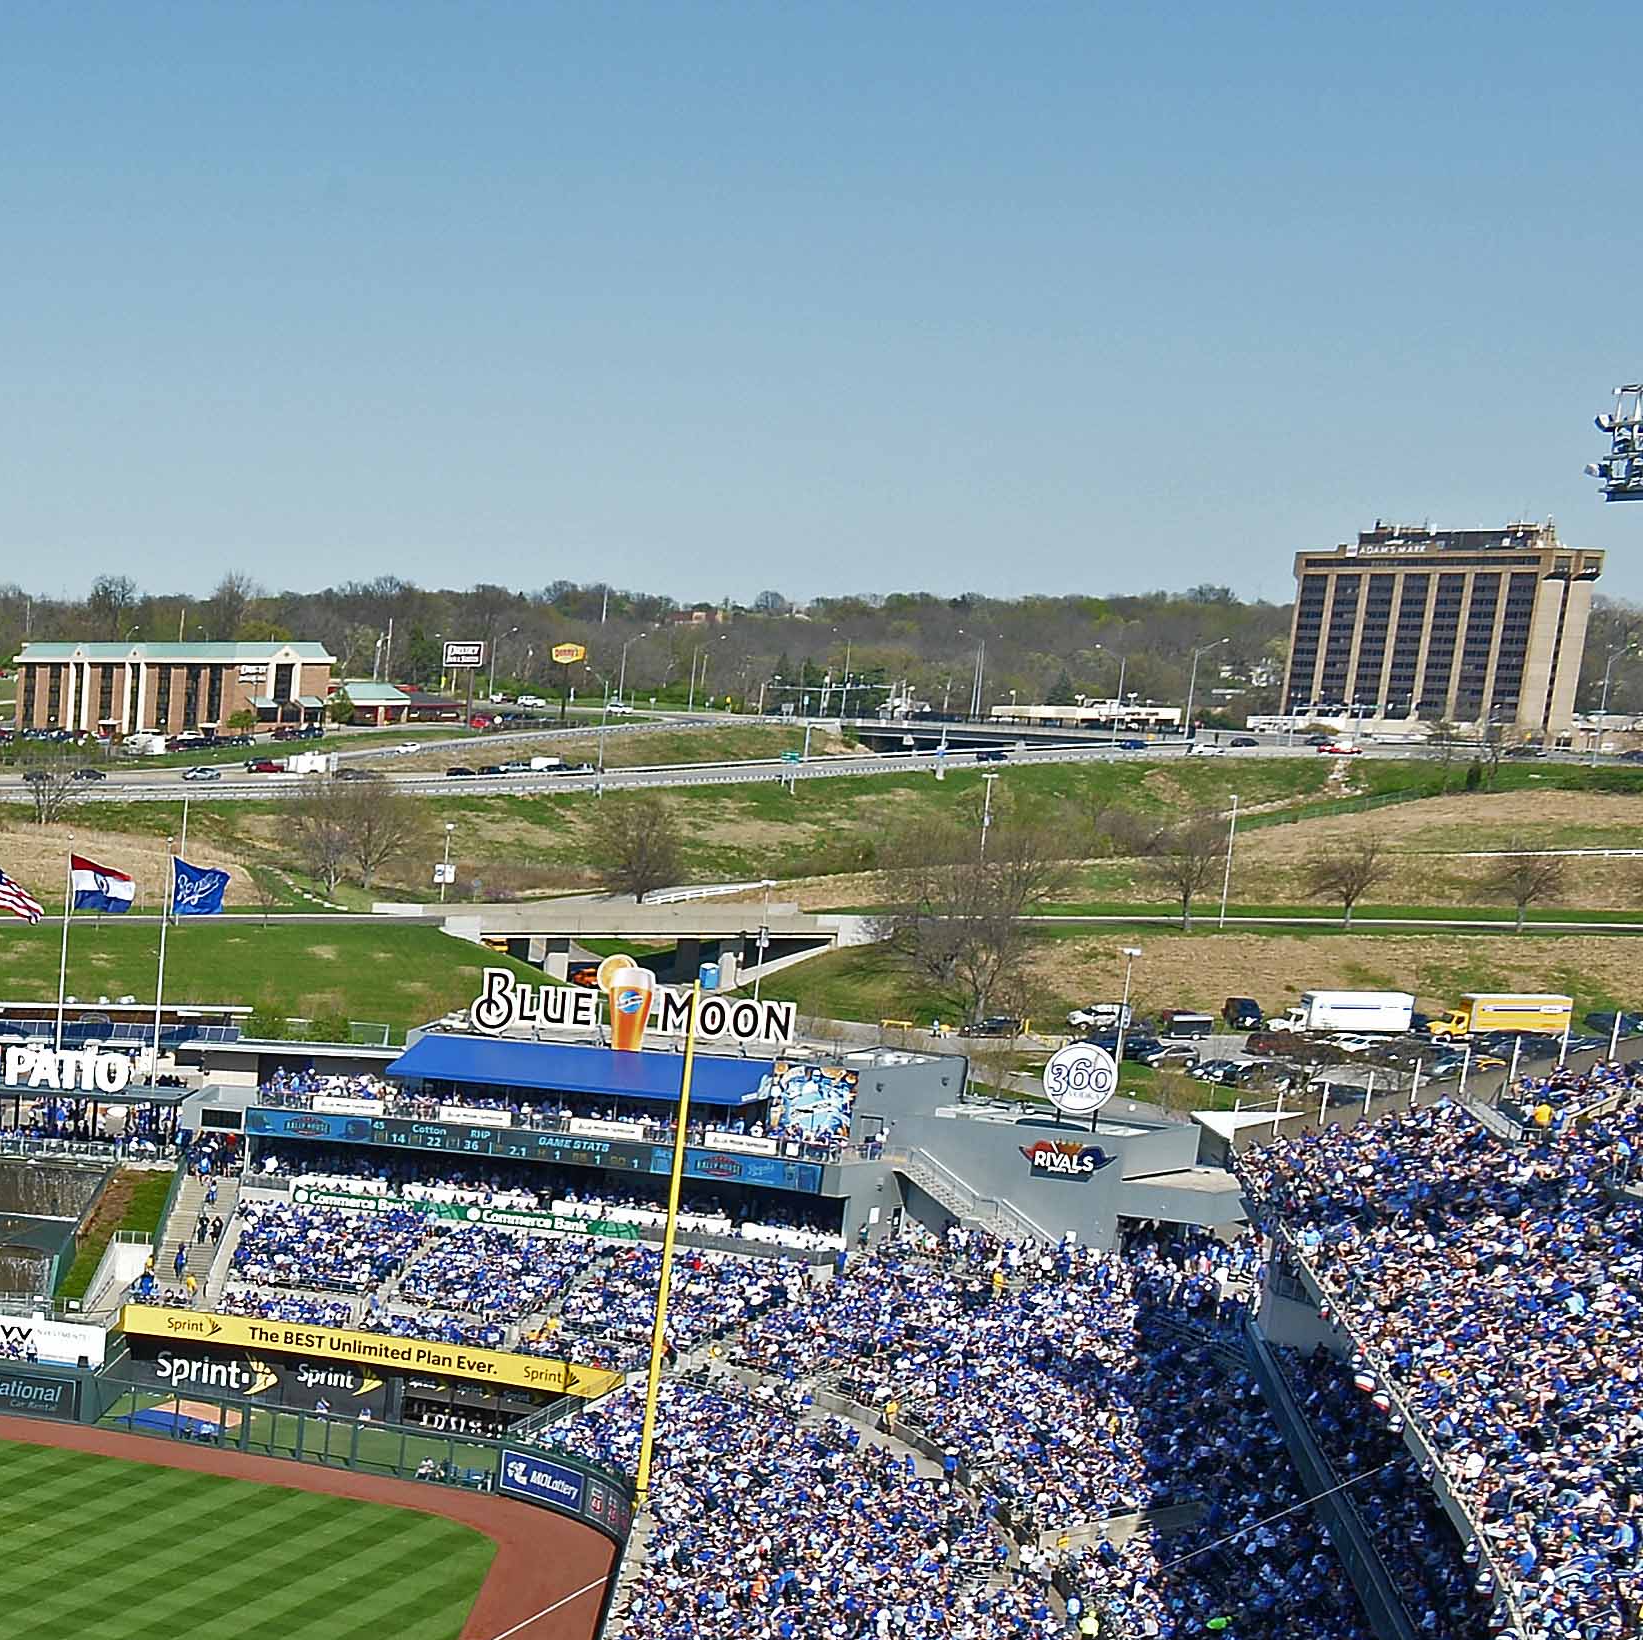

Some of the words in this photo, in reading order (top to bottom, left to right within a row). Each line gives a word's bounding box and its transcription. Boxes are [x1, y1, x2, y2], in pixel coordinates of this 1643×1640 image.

[655, 985, 797, 1043] MOON
[5, 1044, 131, 1093] PATIO
[1048, 1058, 1112, 1096] 360
[412, 1123, 447, 1136] Cotton
[391, 1133, 405, 1144] 14
[426, 1137, 442, 1148] 22
[463, 1140, 479, 1151] 36
[509, 1146, 528, 1157] 2.1
[538, 1136, 572, 1149] GAME
[573, 1140, 610, 1154] STATS
[1034, 1147, 1095, 1173] RIVALS
[308, 1191, 376, 1210] Commerce
[483, 1210, 552, 1229] Commerce
[554, 1217, 588, 1233] Bank
[166, 1316, 204, 1335] Sprint
[248, 1326, 281, 1345] The
[283, 1331, 327, 1350] BEST
[328, 1336, 412, 1363] Unlimited
[416, 1348, 454, 1369] Plan
[456, 1355, 498, 1376] Ever.
[155, 1351, 242, 1390] Sprint
[296, 1363, 356, 1390] Sprint
[523, 1366, 563, 1387] Sprint
[9, 1399, 25, 1408] Car
